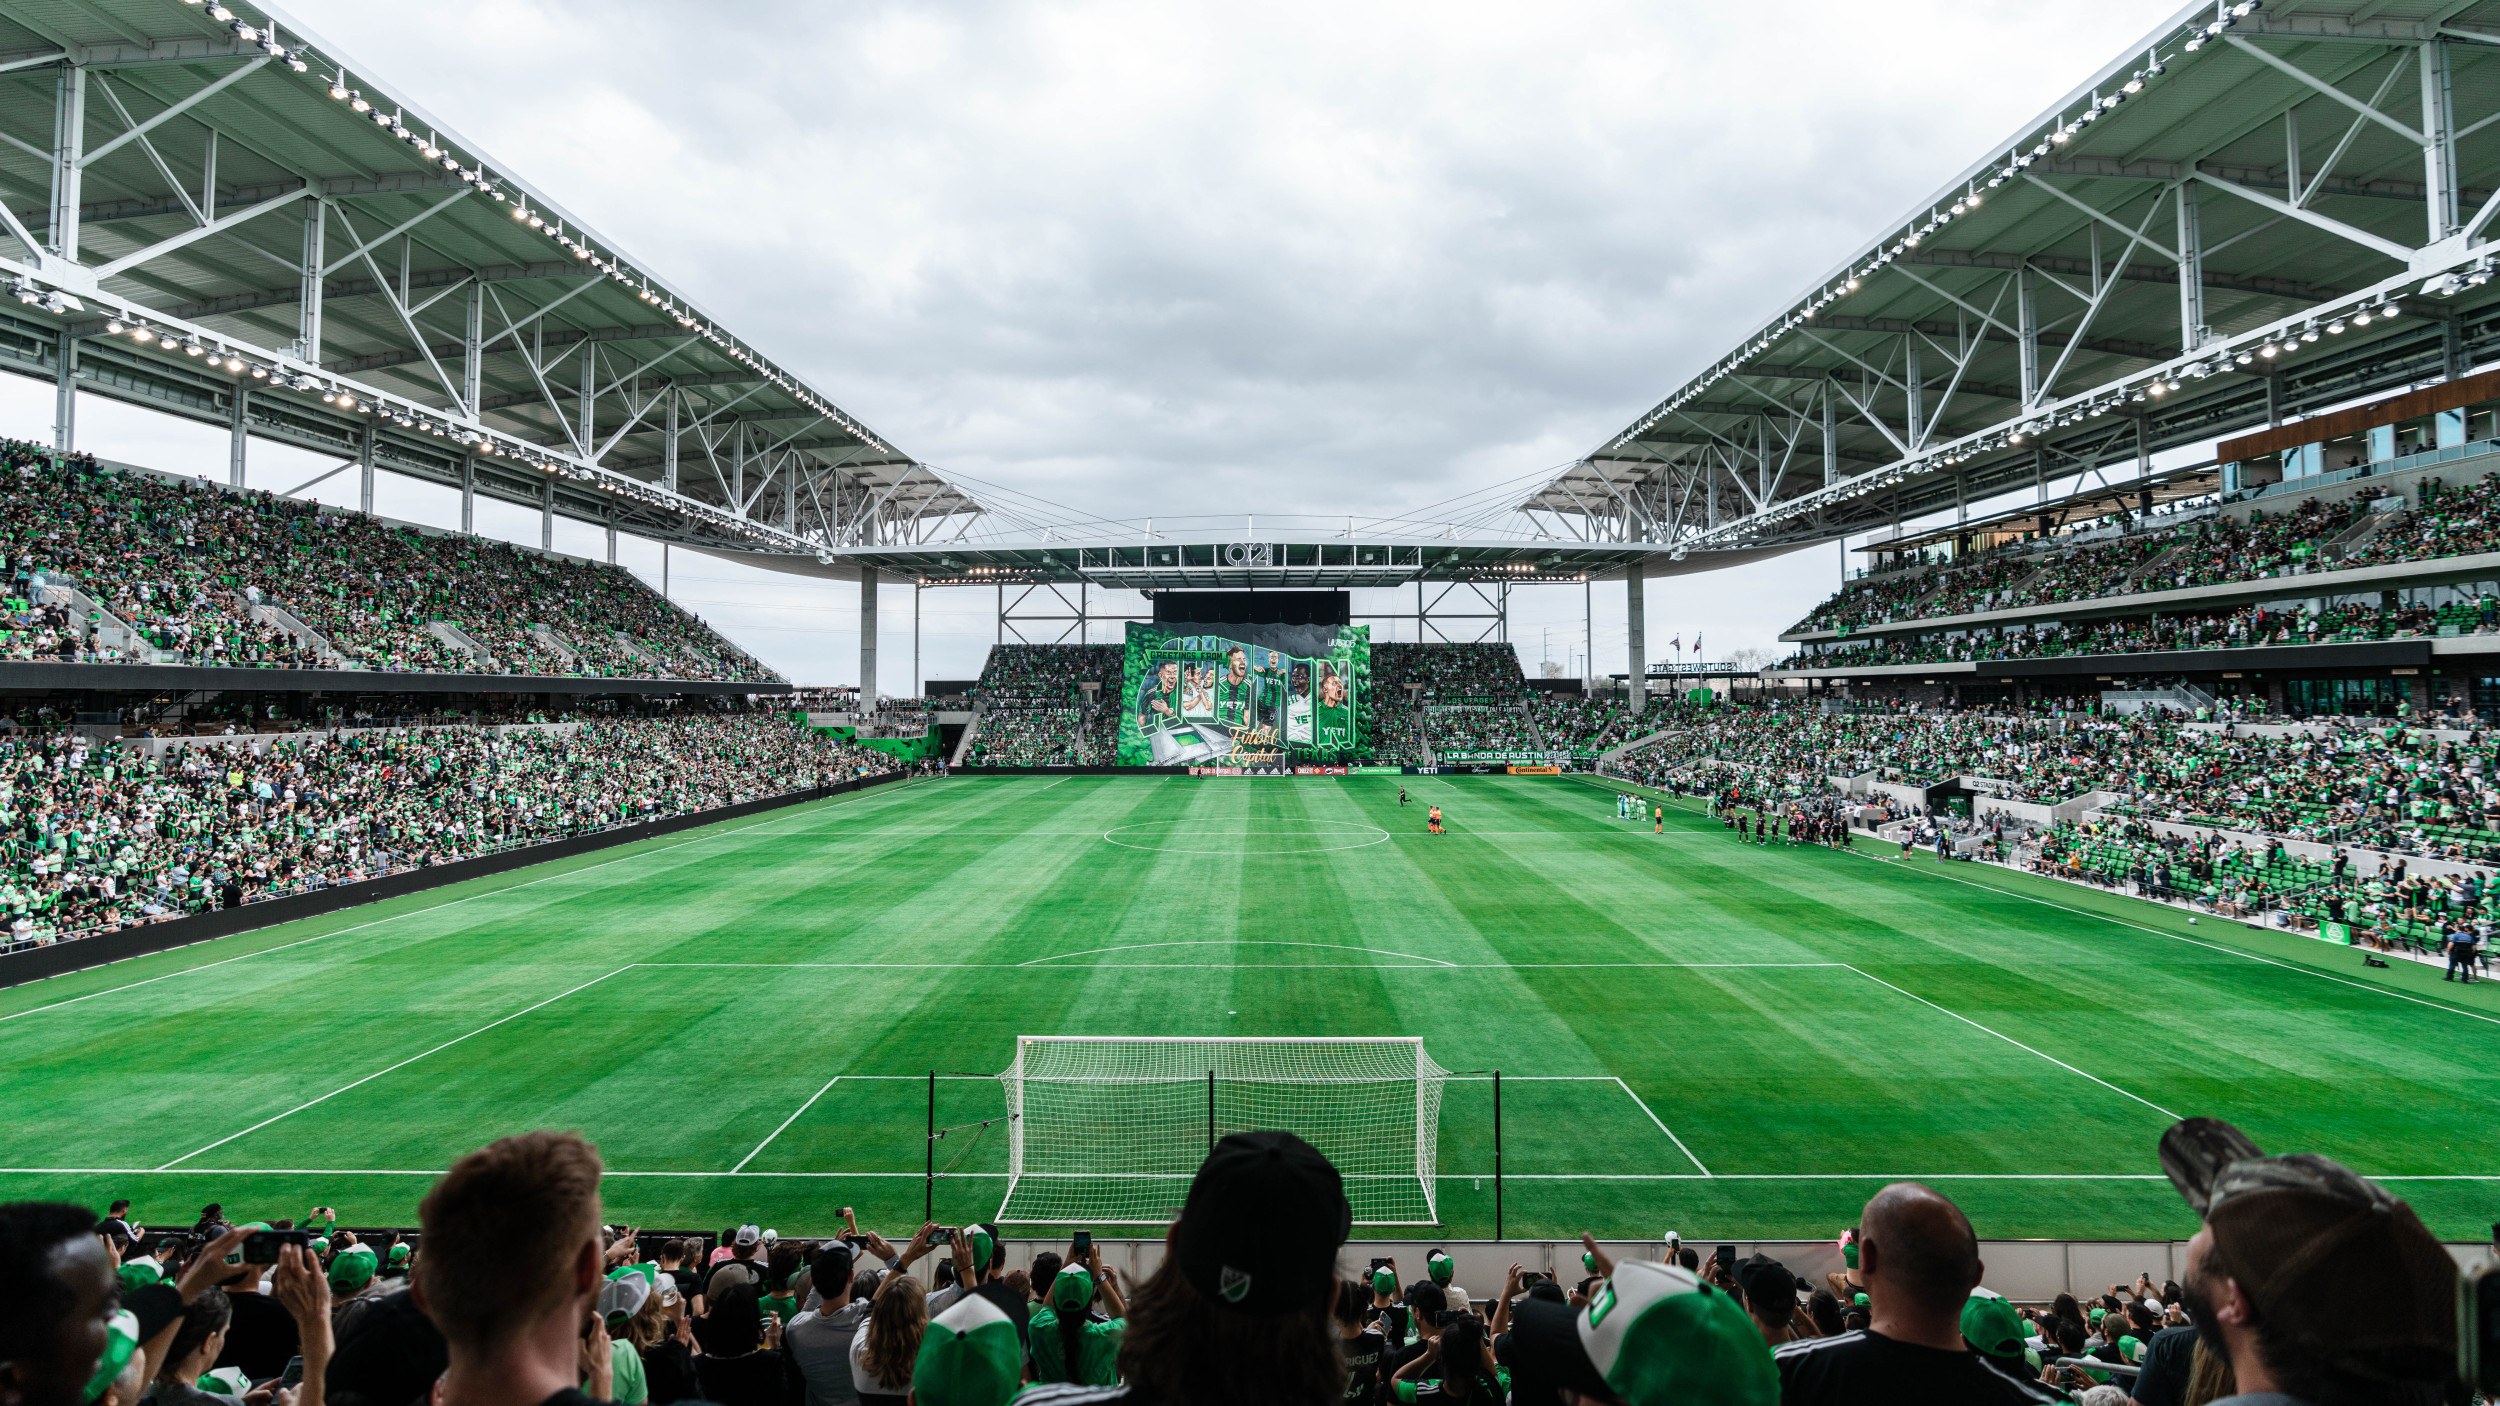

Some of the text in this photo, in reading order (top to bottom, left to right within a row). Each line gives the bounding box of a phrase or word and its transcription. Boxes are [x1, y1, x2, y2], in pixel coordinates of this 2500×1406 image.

[1225, 543, 1268, 567] Q2
[1150, 650, 1223, 661] GREETINGS FROM
[1265, 677, 1281, 686] YETI
[1219, 700, 1246, 711] YETI
[1322, 726, 1346, 737] YETI
[1231, 745, 1278, 767] Capital
[1294, 747, 1338, 761] TEXAS
[1508, 752, 1543, 760] AUSTIN
[1515, 766, 1548, 774] Continental
[1972, 780, 1980, 788] Q2
[1346, 1351, 1380, 1368] RIGUEZ
